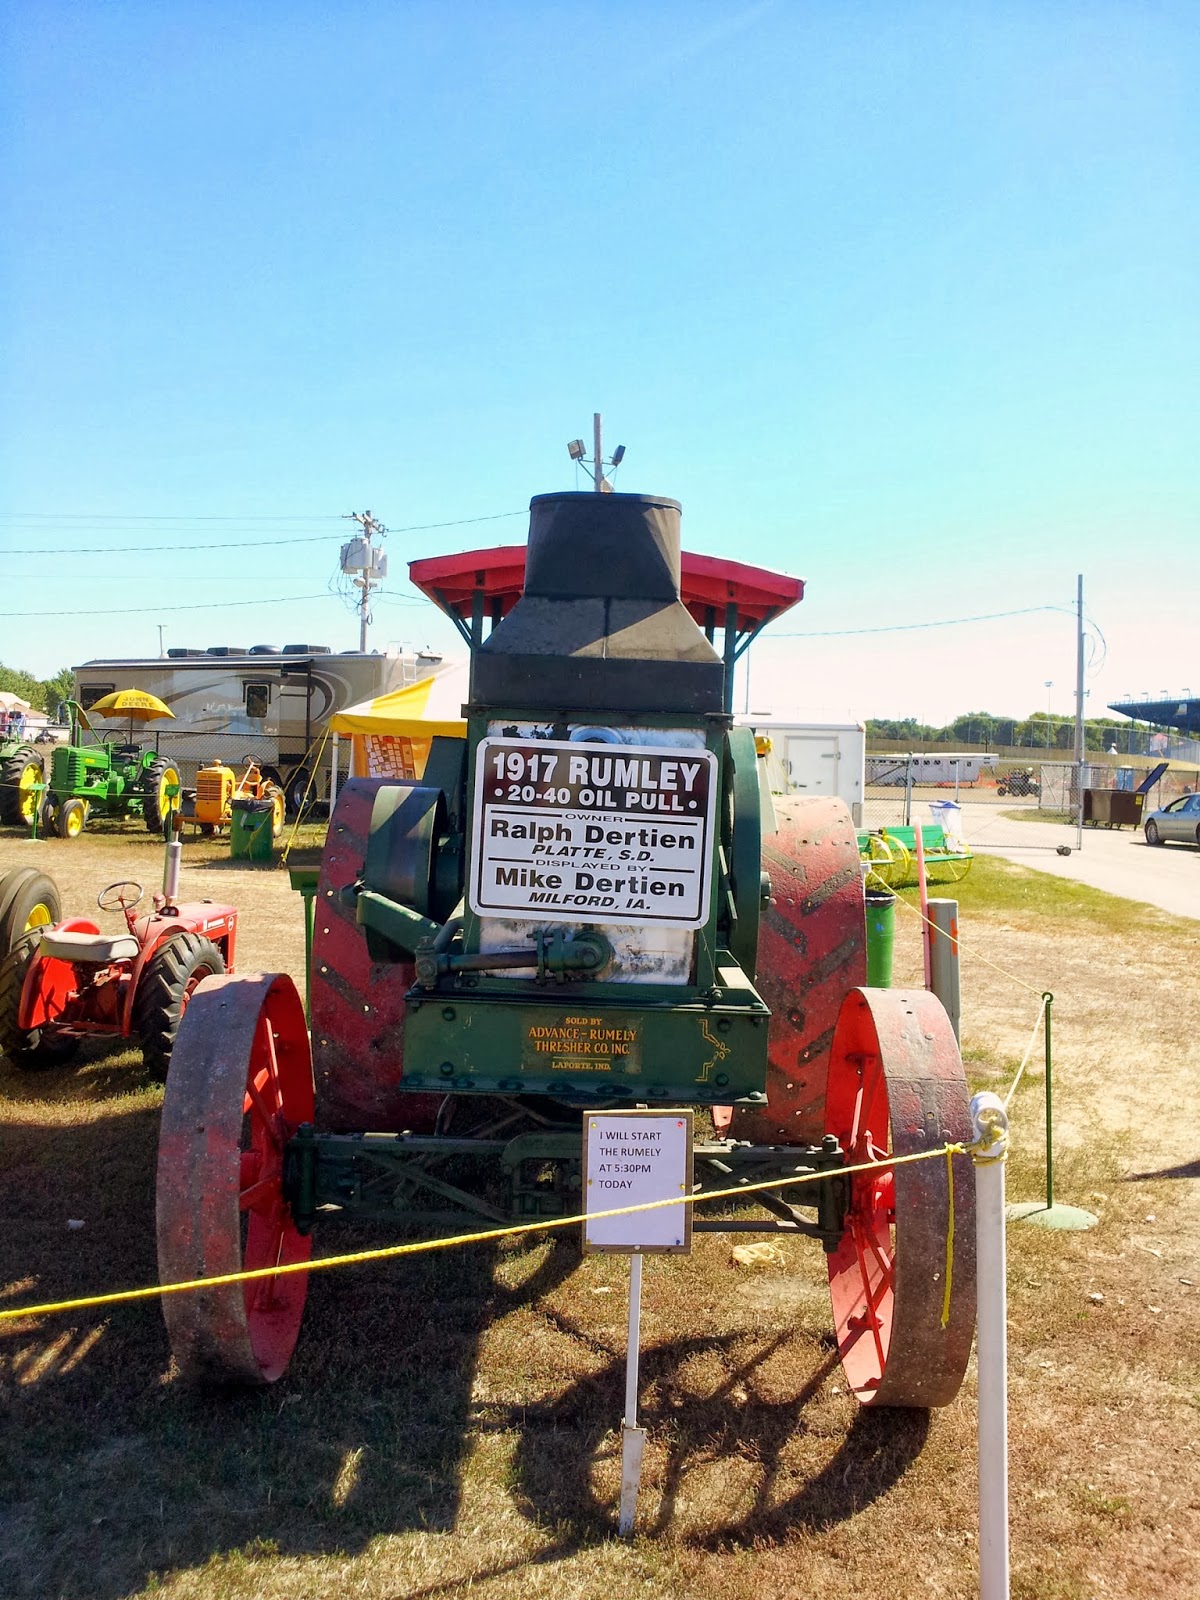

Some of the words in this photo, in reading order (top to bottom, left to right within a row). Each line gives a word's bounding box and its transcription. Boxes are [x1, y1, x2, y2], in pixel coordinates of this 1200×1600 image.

[493, 752, 558, 783] 1917
[568, 756, 701, 792] RUMLEY
[507, 785, 571, 805] 20-40
[578, 789, 617, 808] OIL
[625, 791, 684, 811] PULL
[565, 813, 624, 823] OWNER
[490, 819, 572, 843] Ralph
[585, 825, 695, 849] Dertien
[531, 844, 613, 861] PLATTE,
[618, 849, 655, 862] S.D.
[535, 858, 621, 871] DISPLAYED
[627, 864, 648, 873] BY
[495, 867, 563, 889] Mike
[575, 872, 685, 897] Dertien
[528, 892, 619, 910] MILFORD,
[626, 898, 651, 910] IA.
[565, 1017, 588, 1025] SOLD
[590, 1018, 602, 1026] BY
[534, 1040, 591, 1054] THRESHER
[594, 1043, 609, 1054] CO.
[611, 1043, 631, 1055] INC.
[605, 1131, 629, 1140] WILL
[631, 1131, 662, 1141] START
[599, 1147, 618, 1156] THE
[621, 1148, 662, 1157] RUMELY
[599, 1163, 612, 1173] AT
[614, 1163, 651, 1173] 5:30PM
[599, 1180, 633, 1189] TODAY
